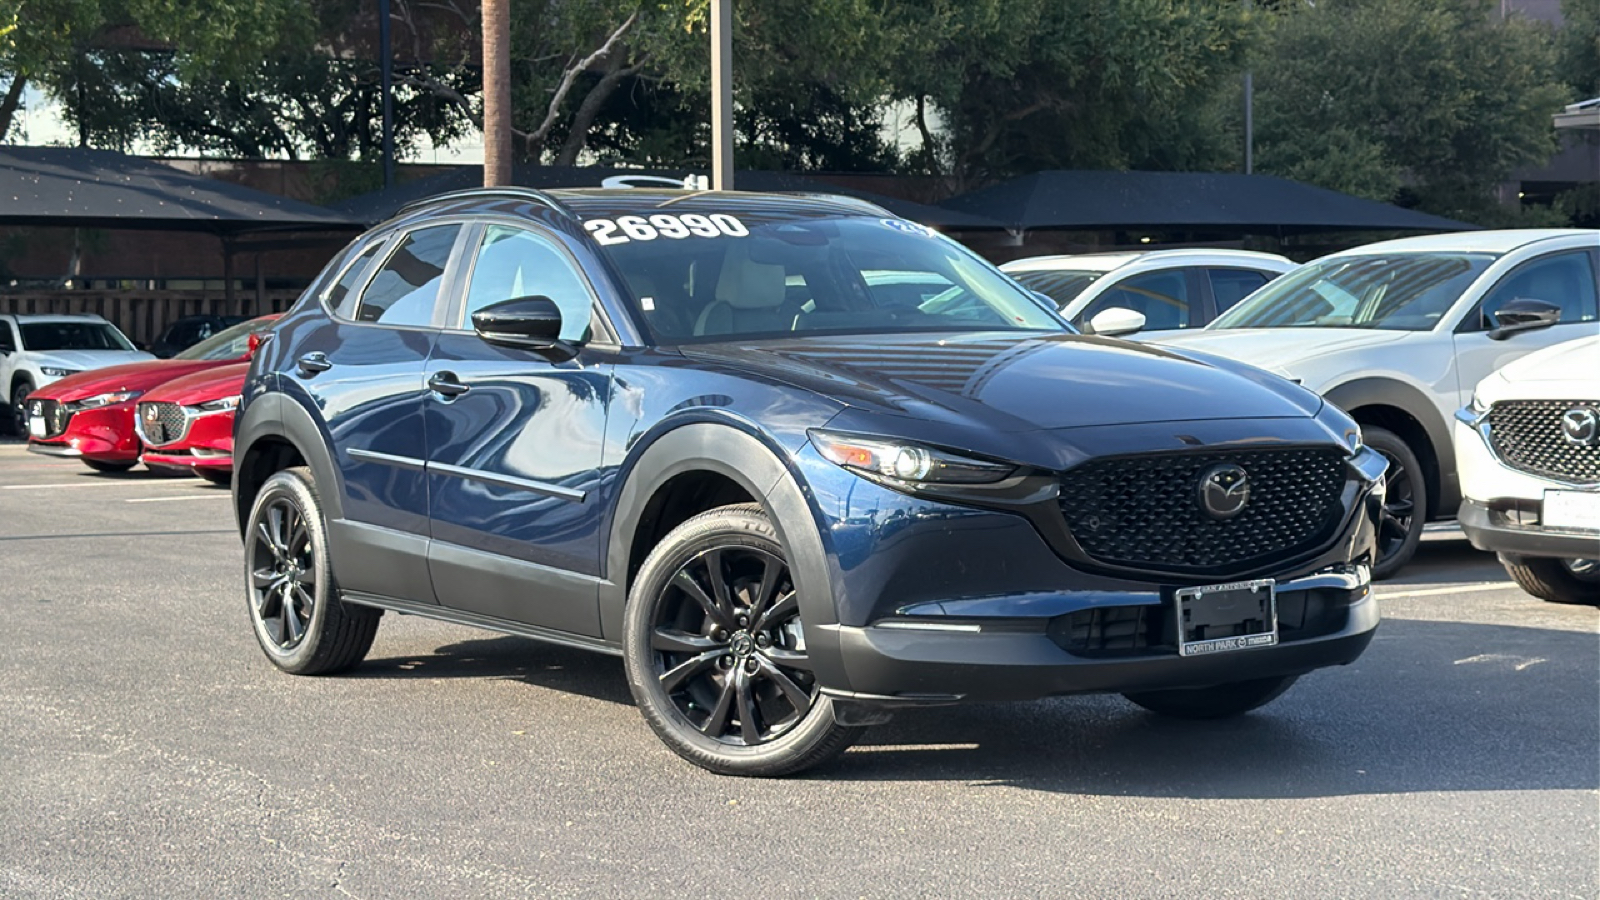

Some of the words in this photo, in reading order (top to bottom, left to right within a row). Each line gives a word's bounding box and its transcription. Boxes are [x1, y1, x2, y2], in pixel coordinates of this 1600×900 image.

[584, 214, 749, 245] 26990
[1186, 643, 1215, 655] NORTH
[1215, 639, 1237, 651] PARK
[1248, 634, 1272, 645] mazda
